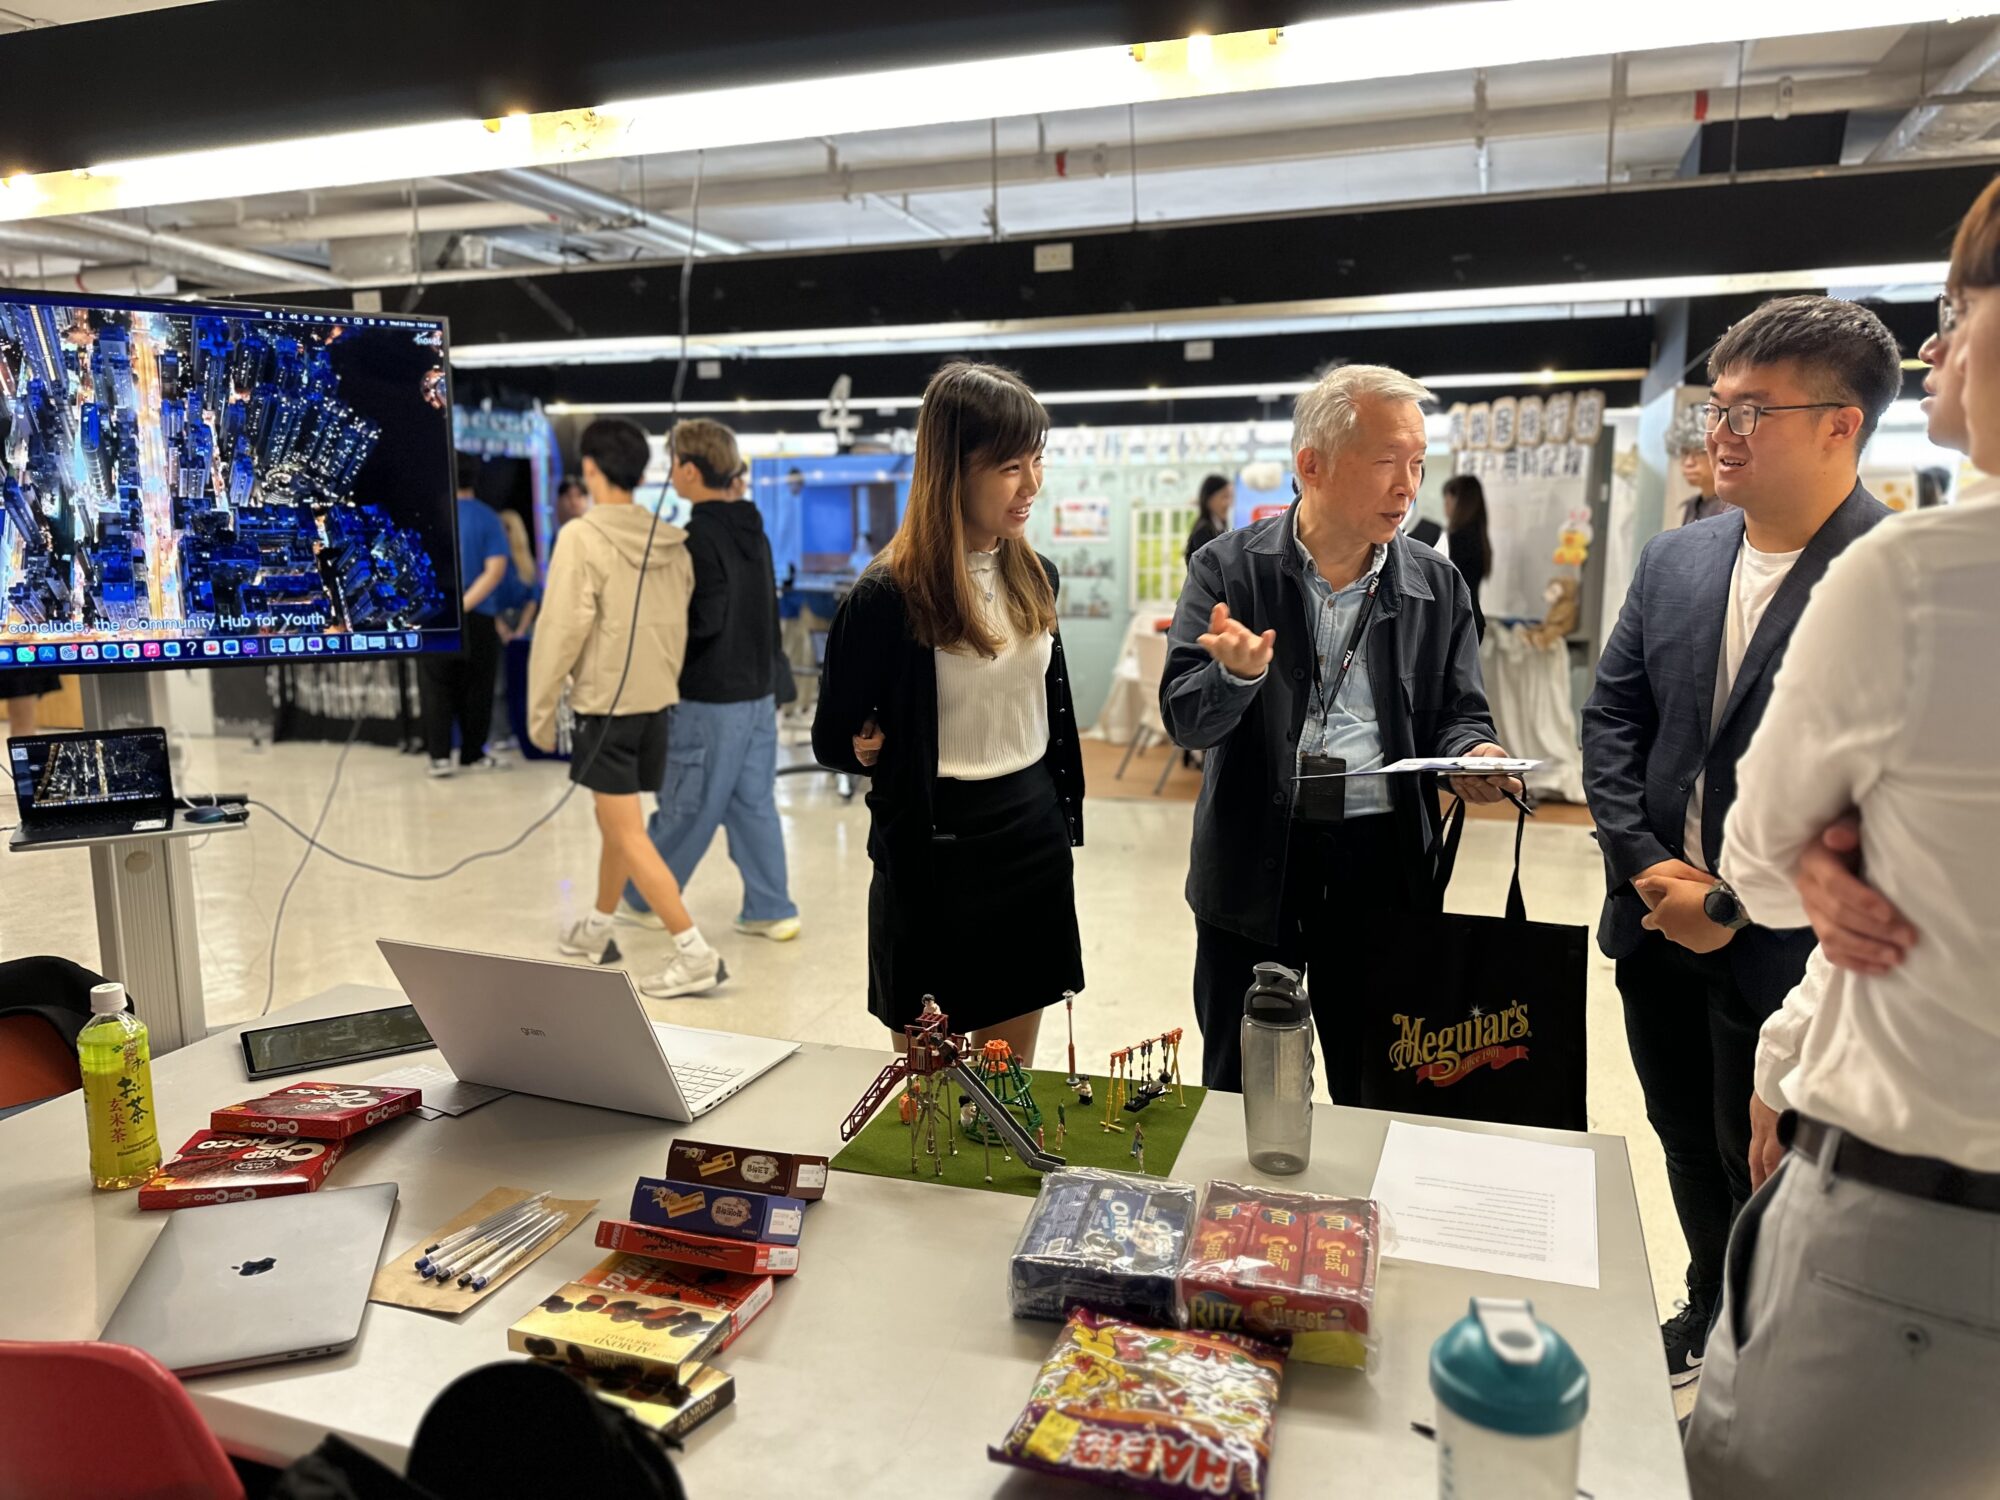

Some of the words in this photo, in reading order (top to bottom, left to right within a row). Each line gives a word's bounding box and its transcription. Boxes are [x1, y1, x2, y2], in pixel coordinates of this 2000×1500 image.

[8, 620, 91, 635] conclude,
[94, 618, 121, 632] the
[126, 615, 215, 632] Community
[220, 614, 251, 629] Hub
[255, 614, 278, 627] for
[281, 612, 325, 627] Youth
[1389, 1000, 1529, 1081] Meguiar's
[109, 1098, 128, 1143] 玄米茶
[197, 1136, 300, 1149] CHOCO
[242, 1142, 326, 1162] CRISP
[1110, 1201, 1132, 1242] OREO
[1269, 1208, 1290, 1227] RITZ
[1325, 1214, 1346, 1232] RITZ
[1316, 1239, 1346, 1272] CHEESE
[1190, 1295, 1244, 1331] RITZ
[1248, 1300, 1327, 1331] CHEESE
[1069, 1430, 1234, 1495] HARIB
